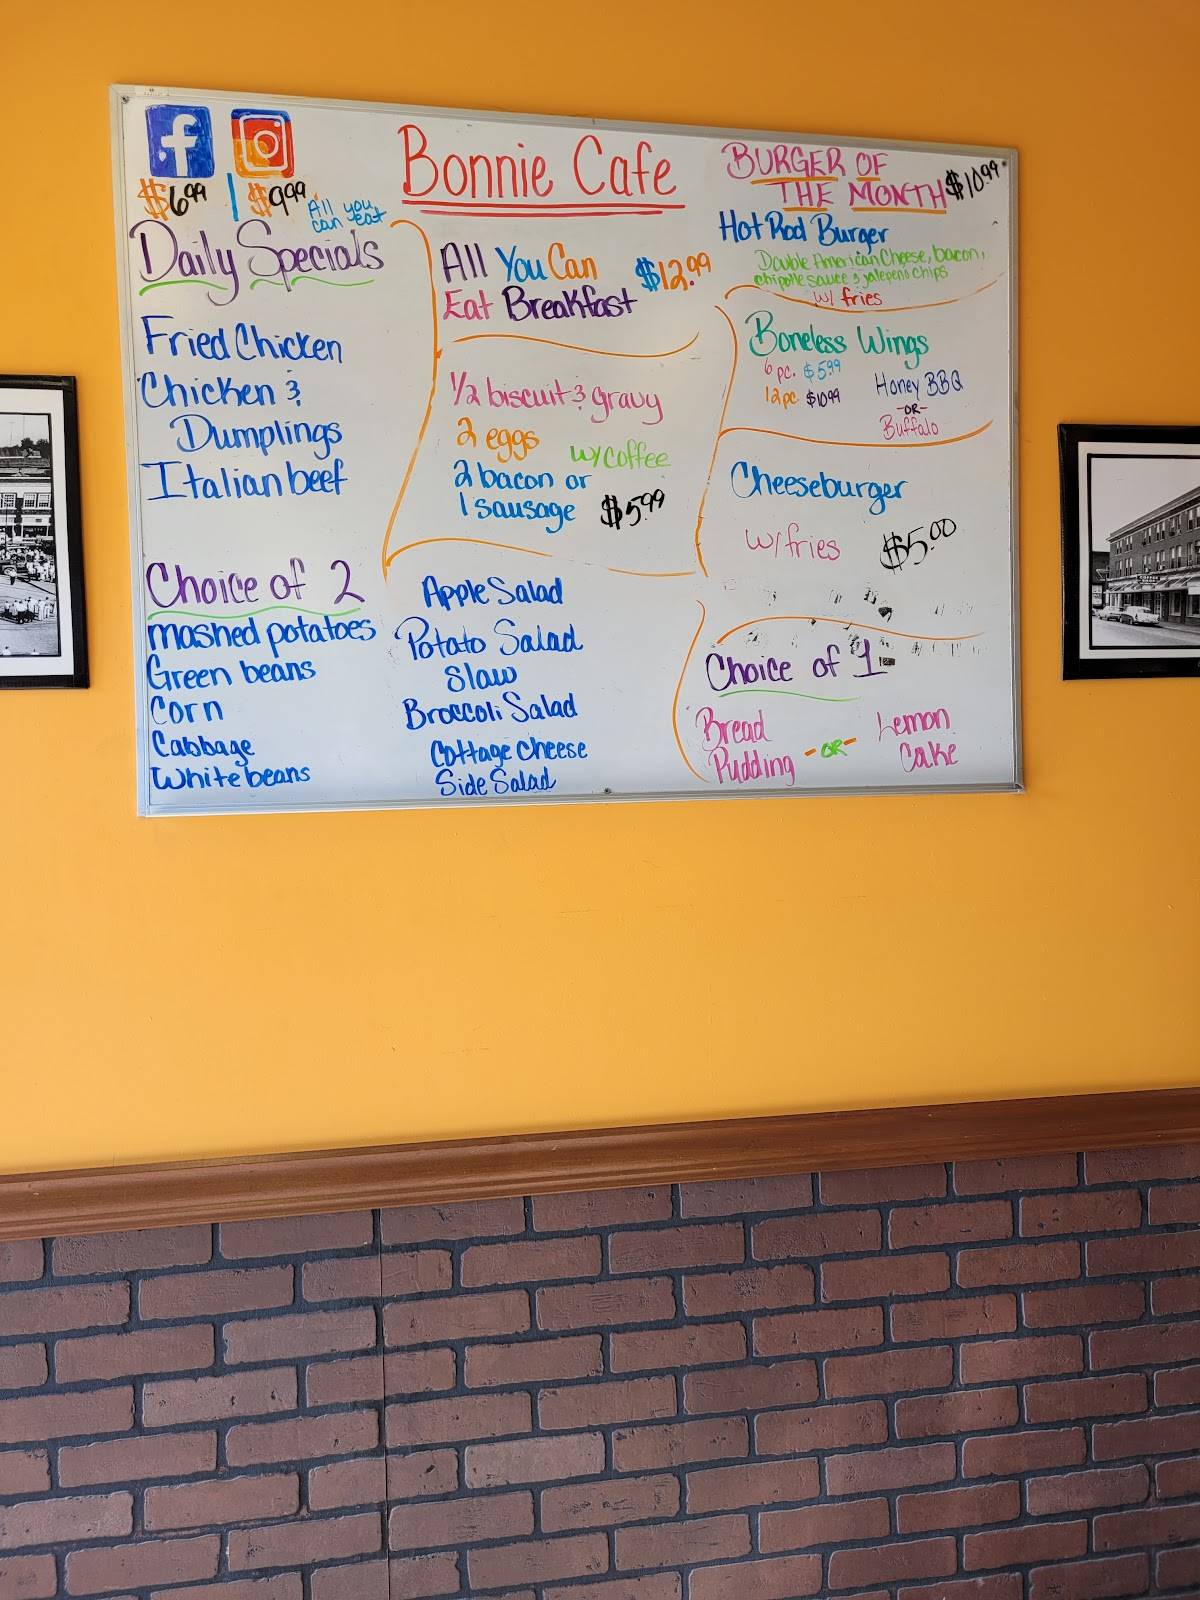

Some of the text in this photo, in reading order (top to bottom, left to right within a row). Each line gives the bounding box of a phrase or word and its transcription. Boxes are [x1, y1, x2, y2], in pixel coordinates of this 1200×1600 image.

[397, 124, 677, 198] Bonnie Cafe
[721, 142, 888, 179] BURGER OF
[307, 198, 374, 221] All you
[765, 181, 948, 209] THE MONTH
[312, 210, 388, 233] can eat
[719, 209, 889, 255] Hot Rod Burger
[129, 219, 385, 306] Daily Specials
[440, 242, 599, 284] All You Can
[754, 249, 809, 271] Double
[813, 251, 881, 269] American
[806, 273, 848, 288] sauce
[841, 287, 883, 307] fries
[442, 285, 638, 322] Eat Breakfast
[141, 315, 343, 364] Fried Chicken
[744, 310, 930, 371] Boneless Wings
[764, 358, 773, 376] 6
[874, 369, 964, 400] Honey BBQ
[141, 371, 276, 408] Chicken
[486, 376, 571, 410] biscuit
[591, 386, 664, 426] gravy
[169, 413, 343, 460] Dumplings
[456, 416, 541, 463] 2 eggs
[879, 414, 939, 440] Buffalo
[139, 458, 349, 501] Italian beef
[453, 459, 593, 490] 2 bacon or
[731, 461, 908, 516] Cheeseburger
[475, 497, 577, 534] sausage
[879, 518, 957, 575] $5.00
[146, 557, 365, 609] Choice of 2
[421, 575, 564, 611] Apple Salad
[267, 615, 377, 658] potatoes
[394, 616, 584, 661] Potato Salad
[146, 653, 316, 692] Green beans
[706, 638, 888, 691] Choice of 1
[150, 695, 224, 725] Corn
[402, 691, 578, 730] Broccoli Salad
[876, 708, 951, 742] Lemon
[695, 706, 771, 752] Bread
[151, 729, 255, 767] Cabbage
[430, 739, 513, 769] Cottage
[707, 746, 796, 787] Pudding
[900, 742, 959, 773] Cake
[150, 766, 311, 790] White beans
[435, 766, 557, 797] Side Salad
